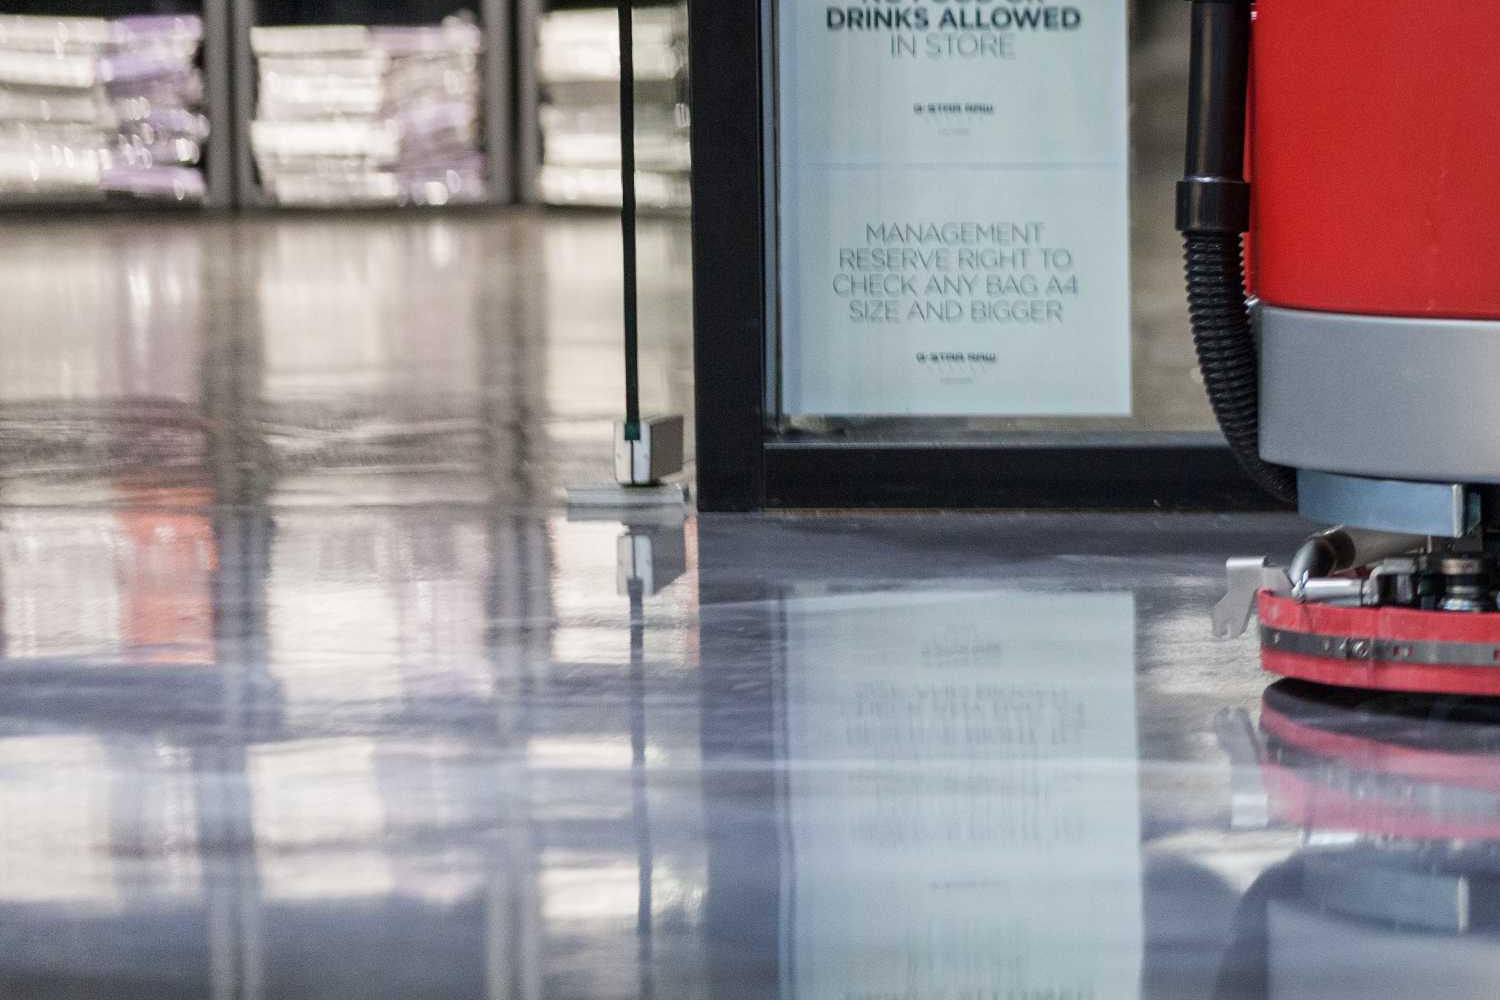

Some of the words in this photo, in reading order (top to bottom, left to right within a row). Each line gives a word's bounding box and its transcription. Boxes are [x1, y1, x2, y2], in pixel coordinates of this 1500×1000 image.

[826, 7, 928, 30] DRINKS
[939, 6, 1081, 30] ALLOWED
[890, 34, 915, 57] IN
[926, 33, 1016, 58] STORE
[866, 222, 1045, 243] MANAGEMENT
[839, 247, 948, 270] RESERVE
[958, 247, 1030, 270] RIGHT
[1038, 247, 1073, 269] TO
[832, 273, 917, 297] CHECK
[924, 274, 977, 296] ANY
[986, 273, 1038, 296] BAG
[1045, 274, 1079, 296] A4
[848, 299, 898, 321] SIZE
[907, 299, 962, 321] AND
[970, 299, 1063, 322] BIGGER
